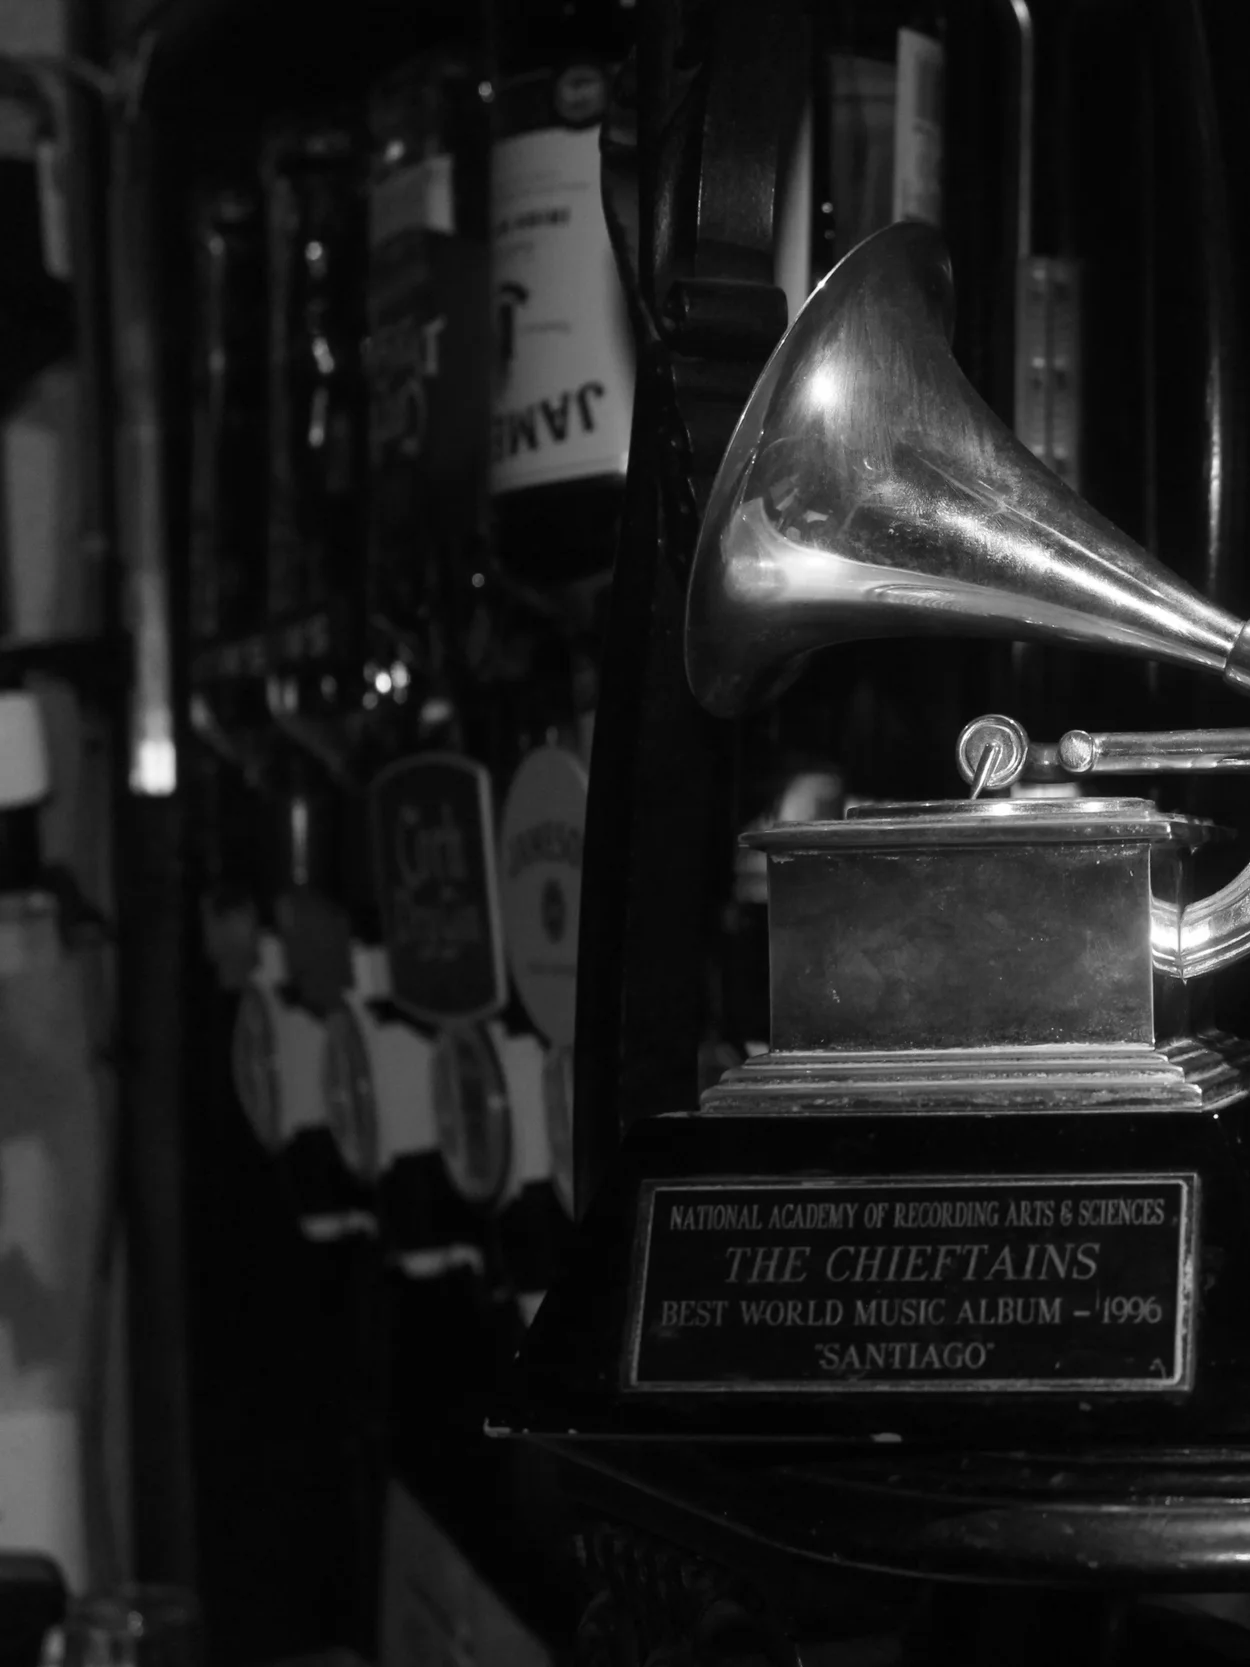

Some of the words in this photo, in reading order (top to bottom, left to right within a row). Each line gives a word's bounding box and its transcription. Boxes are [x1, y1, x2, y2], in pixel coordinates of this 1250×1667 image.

[670, 1204, 763, 1230] NATIONAL
[768, 1203, 859, 1230] ACADEMY
[863, 1202, 889, 1229] OF
[893, 1201, 999, 1228] RECORDING
[1004, 1200, 1054, 1227] ARTS
[1059, 1200, 1072, 1226] &
[1077, 1198, 1165, 1225] SCIENCES
[725, 1246, 811, 1283] THE
[826, 1243, 1100, 1282] CHIEFTAINS
[661, 1300, 728, 1327] BEST
[740, 1299, 843, 1326] WORLD
[854, 1298, 945, 1325] MUSIC
[956, 1297, 1062, 1325] ALBUM
[1102, 1295, 1162, 1324] 1996
